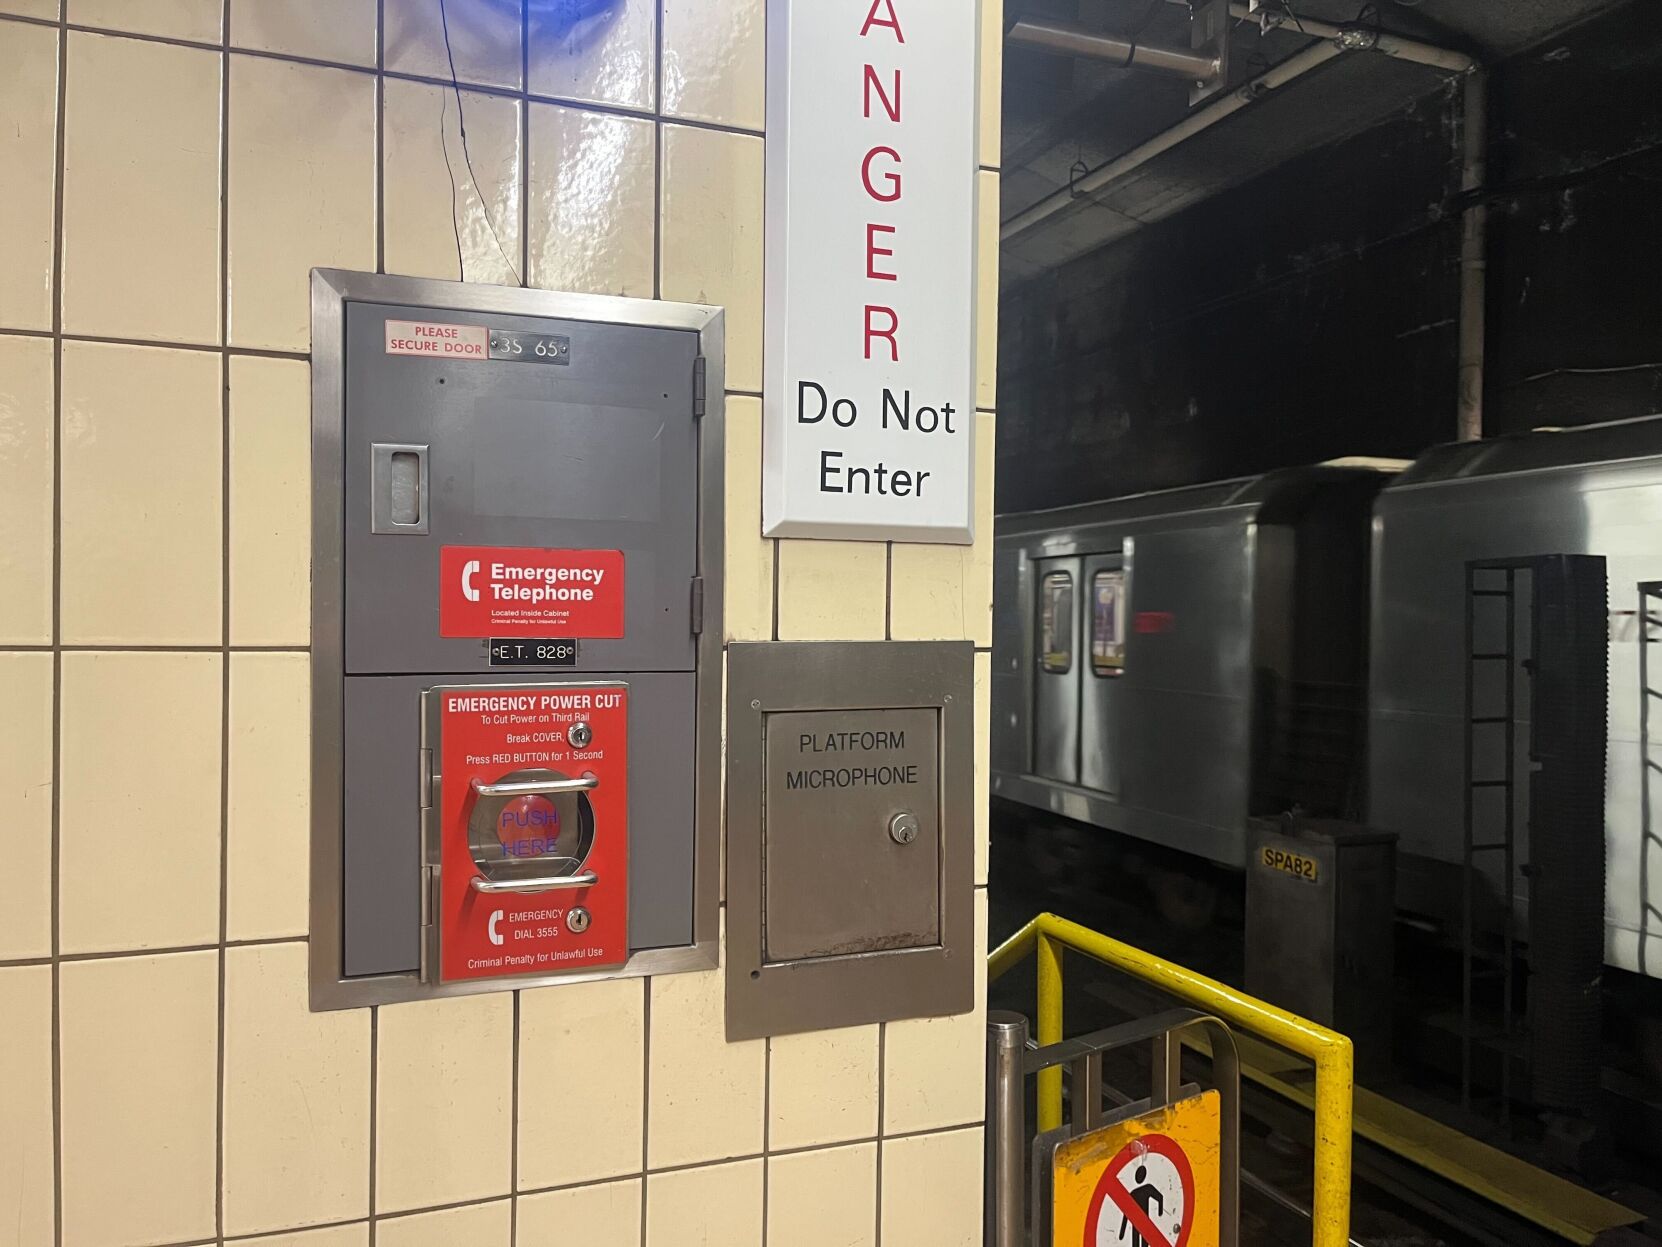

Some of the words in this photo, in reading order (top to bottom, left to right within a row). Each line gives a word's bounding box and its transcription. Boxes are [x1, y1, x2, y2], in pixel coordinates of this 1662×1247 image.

[415, 326, 458, 338] PLEASE
[391, 339, 438, 351] SECURE
[444, 343, 482, 354] DOOR
[500, 337, 522, 354] 3S
[535, 340, 558, 357] 65
[798, 380, 857, 427] Do
[882, 388, 956, 433] Not
[820, 450, 930, 497] Enter
[491, 563, 604, 585] Emergency
[490, 584, 594, 604] Telephone
[500, 645, 529, 659] E.T.
[536, 645, 567, 659] 828
[449, 696, 537, 712] EMERGENCY
[541, 695, 591, 710] POWER
[595, 694, 622, 708] CUT
[481, 715, 491, 725] To
[494, 714, 508, 724] Cut
[510, 713, 536, 724] Power
[539, 715, 549, 723] on
[552, 713, 572, 722] Third
[574, 712, 590, 722] Rail
[507, 734, 531, 744] Break
[800, 731, 905, 752] PLATFORM
[466, 755, 490, 764] Press
[493, 753, 511, 763] RED
[513, 752, 549, 762] BUTTON
[551, 752, 563, 761] for
[566, 752, 570, 760] 1
[573, 750, 603, 759] Second
[787, 766, 918, 789] MICROPHONE
[502, 810, 557, 828] PUSH
[501, 838, 557, 857] HERE
[1264, 849, 1313, 877] SPA82
[509, 909, 564, 923] EMERGENCY
[514, 929, 535, 940] DIAL
[536, 927, 558, 938] 3555
[468, 959, 503, 969] Criminal
[504, 955, 535, 967] Penalty
[537, 954, 549, 963] for
[550, 950, 586, 961] Unlawful
[587, 948, 604, 957] Use
